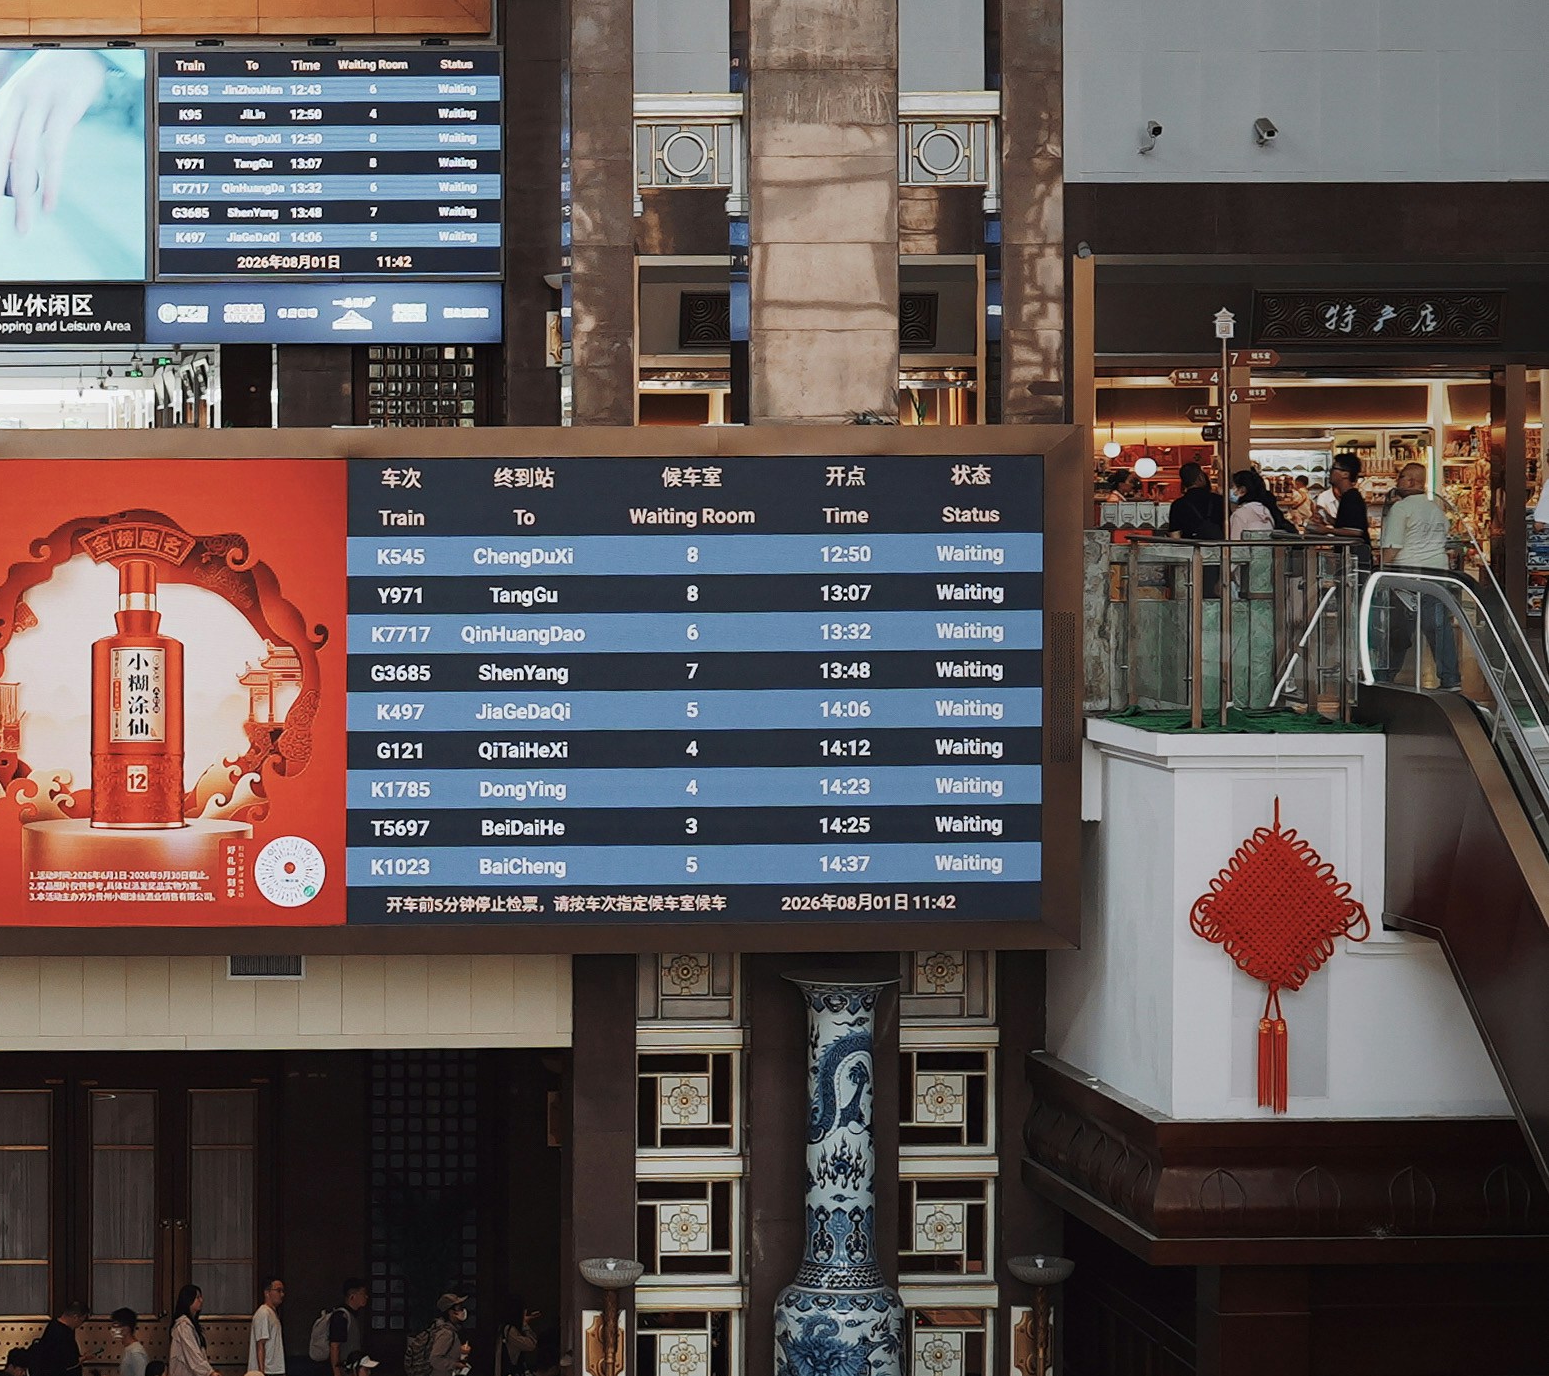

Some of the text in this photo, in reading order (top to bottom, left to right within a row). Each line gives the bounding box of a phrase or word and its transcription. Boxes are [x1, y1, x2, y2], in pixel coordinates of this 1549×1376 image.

[179, 108, 203, 121] K95
[290, 107, 323, 121] 12:50
[171, 206, 323, 219] G3685 13:48
[237, 254, 413, 270] 2026年08月01日 11:42
[35, 320, 57, 331] and
[57, 320, 102, 331] Leisure
[104, 321, 131, 331] Area
[1325, 304, 1438, 333] 特产店
[1231, 353, 1238, 365] 7
[1210, 372, 1219, 383] 4
[1230, 390, 1237, 402] 6
[1216, 409, 1222, 420] 5
[381, 464, 991, 488] 车次 终到站 候车室 开点 状态
[378, 506, 1000, 529] Train To Waiting Room Time Status
[378, 545, 872, 568] K545 ChengDuXi 12:50
[378, 583, 871, 608] Y971 TangGu 13:07
[372, 622, 872, 645] K7717 QinHuangDao 13:32
[371, 661, 871, 685] G3685 ShenYang 13:48
[127, 652, 151, 738] 小糊涂仙
[377, 700, 871, 721] K497 JiaGeDaQi 14:06
[377, 739, 871, 760] G121 QiTaiHeXi 14:12
[128, 769, 146, 792] 12
[372, 778, 871, 801] K1785 DongYing 14:23
[371, 816, 871, 837] T5697 BeiDaiHe 14:25
[371, 855, 870, 878] K1023 BaiCheng 14:37
[387, 893, 956, 913] 开车前5分钟停止检票，请按车次指定候车室候车 2026年08月01日 11:42
